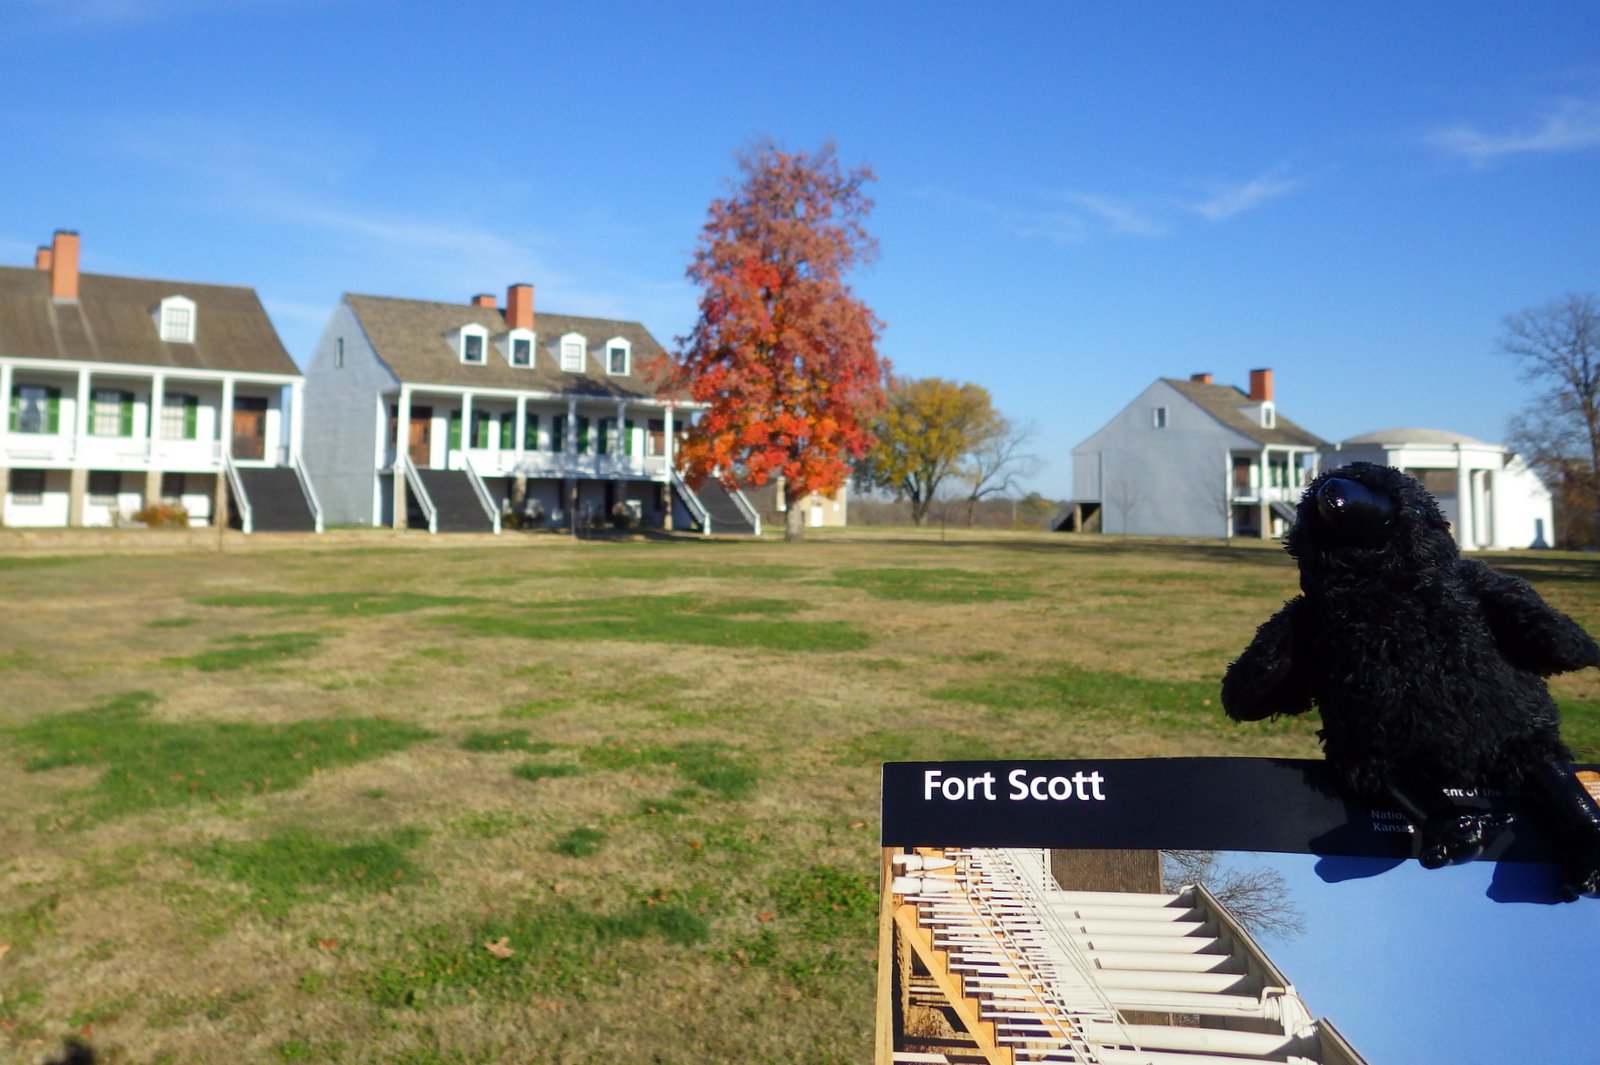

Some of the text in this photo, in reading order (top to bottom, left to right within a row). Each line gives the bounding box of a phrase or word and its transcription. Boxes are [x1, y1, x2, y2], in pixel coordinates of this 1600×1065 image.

[923, 768, 1106, 801] Fort Scott
[1371, 809, 1406, 821] Natio
[1372, 821, 1415, 834] Kansas
